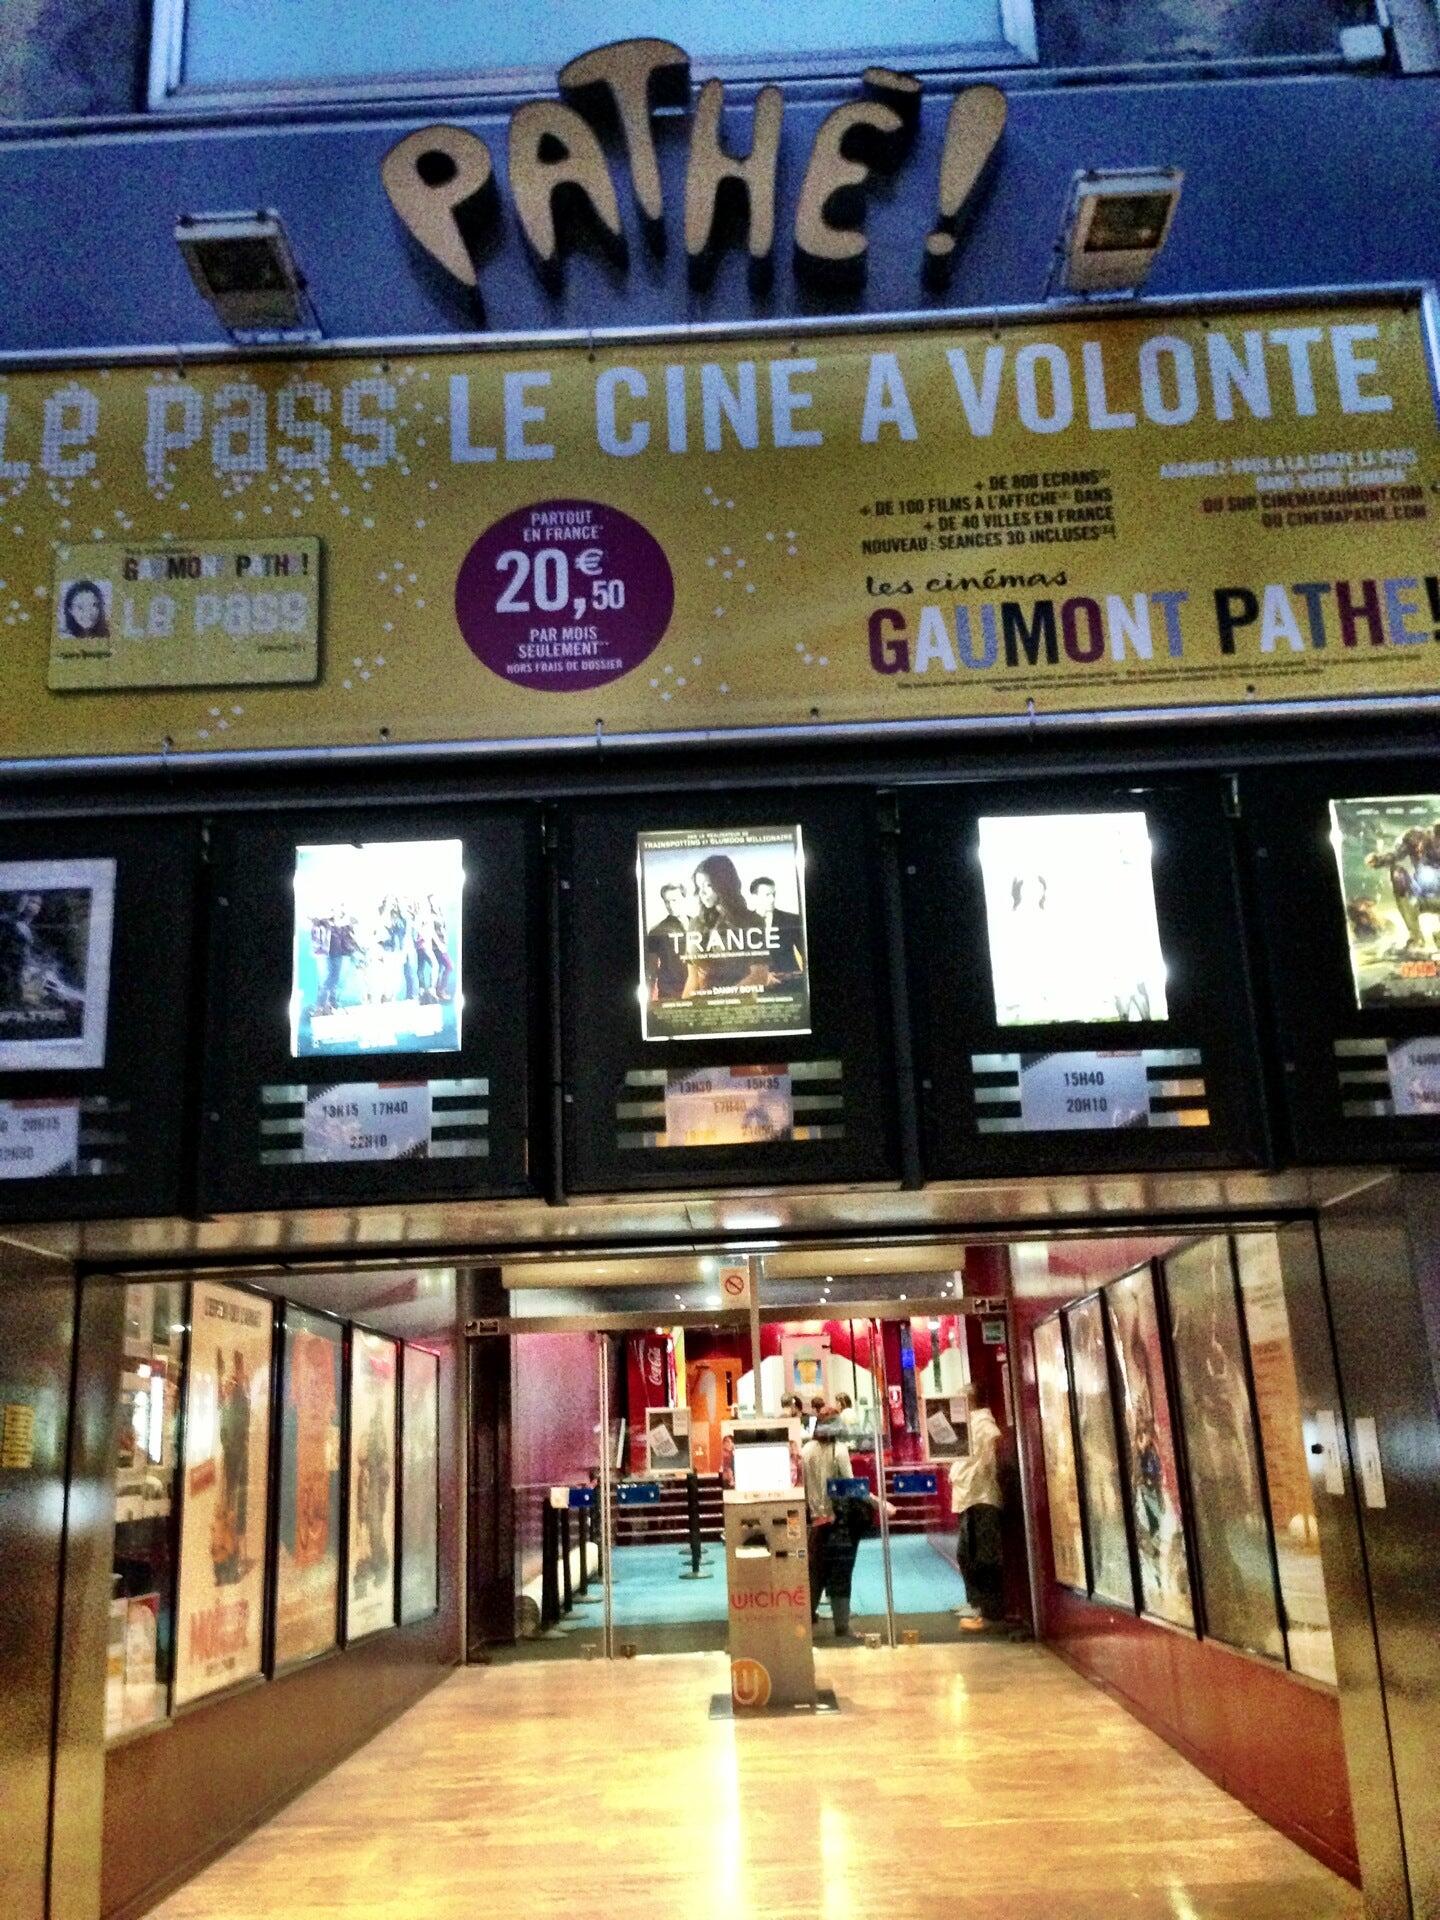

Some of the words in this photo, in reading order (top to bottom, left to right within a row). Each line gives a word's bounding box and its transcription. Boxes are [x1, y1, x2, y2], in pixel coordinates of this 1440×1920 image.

[449, 370, 555, 463] LE
[596, 358, 823, 457] CINE
[860, 352, 918, 443] A
[946, 324, 1393, 438] VOLONTE
[989, 475, 1007, 490] DE
[875, 500, 894, 516] DE
[899, 499, 924, 515] 100
[928, 496, 971, 514] FILMS
[1074, 487, 1112, 504] DANS
[531, 510, 592, 526] PARTOUT
[938, 516, 956, 532] DE
[962, 514, 979, 531] 40
[982, 512, 1031, 529] VILLES
[1034, 510, 1053, 526] EN
[1058, 505, 1114, 524] FRANCE
[523, 528, 541, 542] EN
[938, 532, 1002, 550] SEANCES
[1007, 529, 1025, 546] 3D
[530, 627, 557, 642] PAR
[562, 626, 598, 641] MOIS
[867, 591, 1188, 676] GAUMONT
[507, 662, 532, 674] HORS
[536, 661, 563, 673] FRAIS
[566, 661, 577, 672] DE
[581, 659, 623, 671] DOSSIER
[668, 926, 781, 955] TRANCE
[1063, 1071, 1105, 1087] 15H40
[322, 1104, 358, 1119] 13H15
[372, 1101, 408, 1116] 17H40
